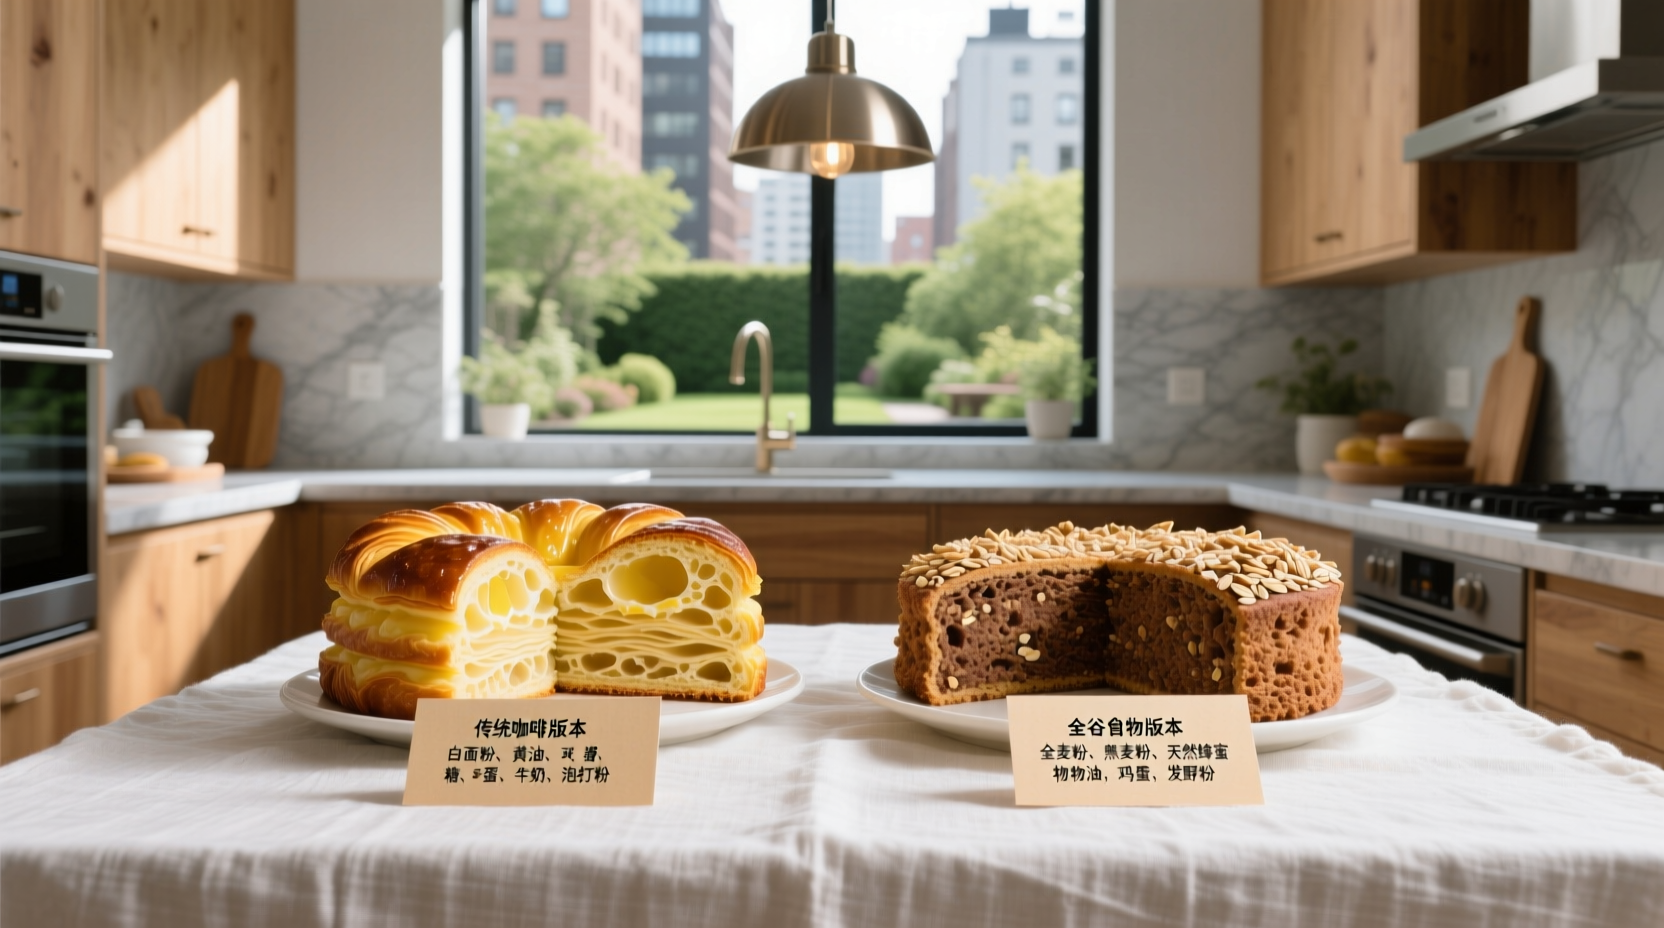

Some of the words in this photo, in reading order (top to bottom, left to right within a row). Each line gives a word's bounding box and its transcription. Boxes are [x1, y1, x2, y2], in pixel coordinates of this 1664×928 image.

[474, 718, 587, 738] 传统咖啡版本
